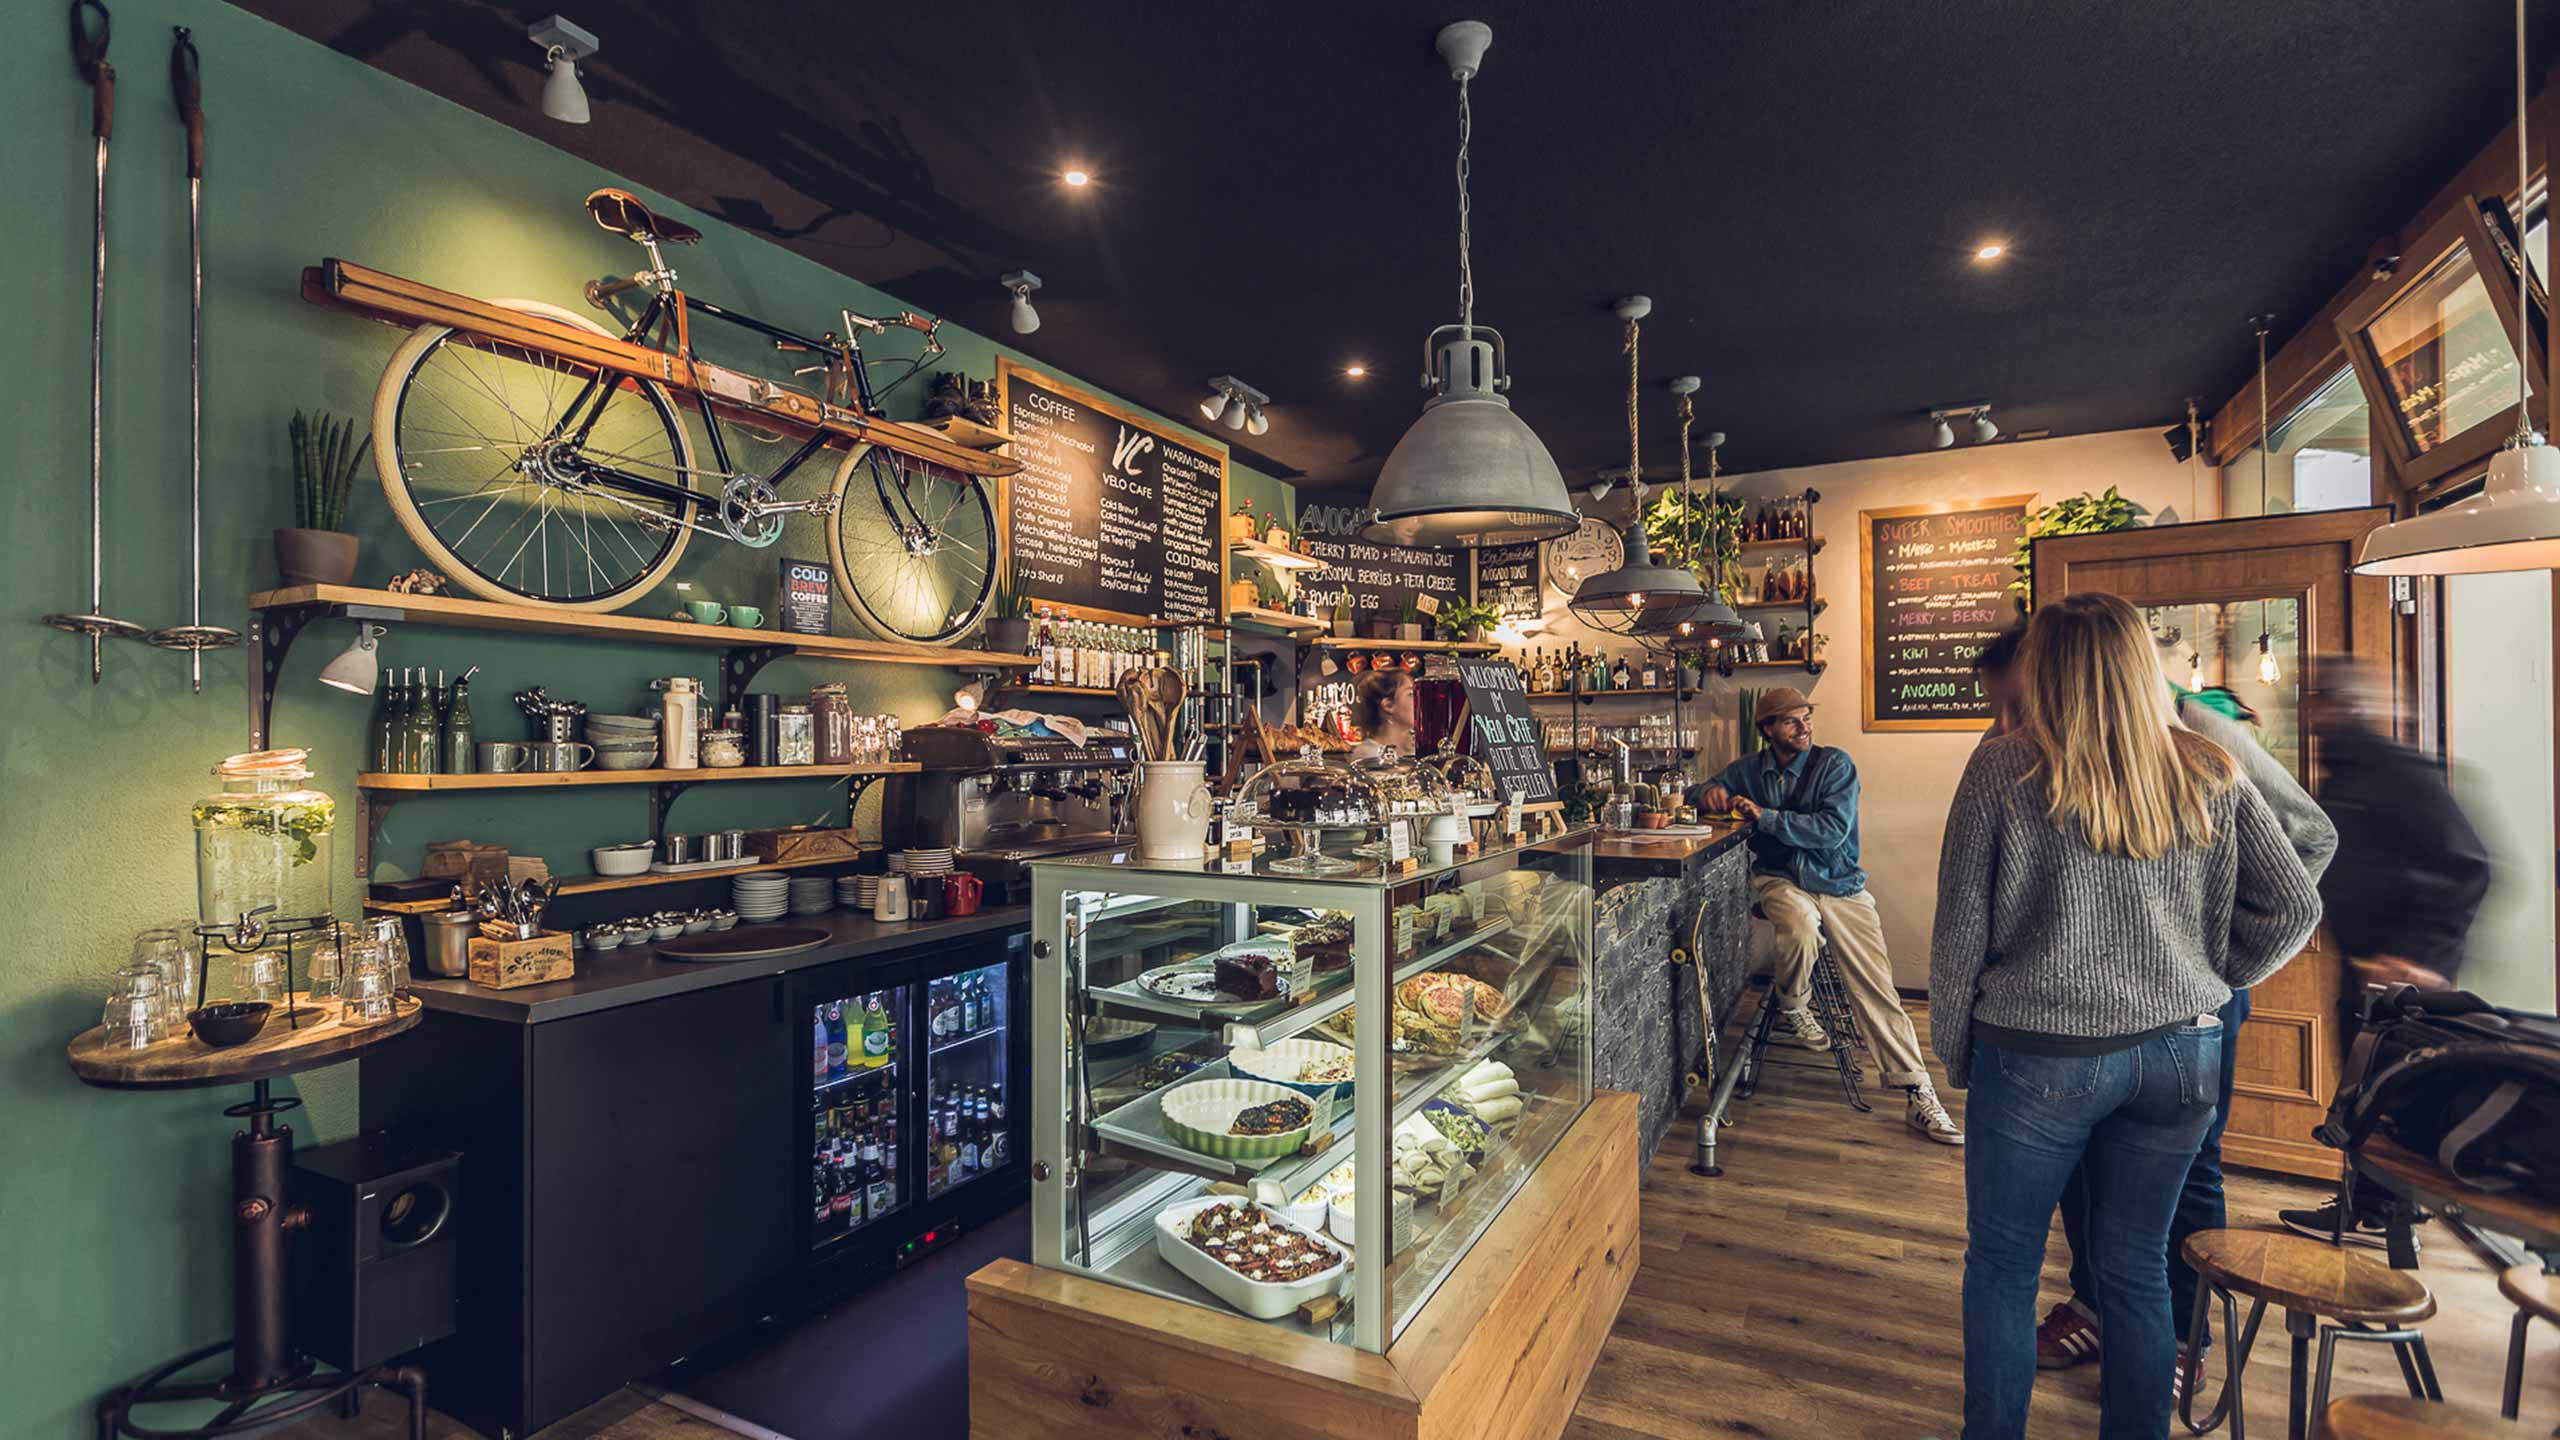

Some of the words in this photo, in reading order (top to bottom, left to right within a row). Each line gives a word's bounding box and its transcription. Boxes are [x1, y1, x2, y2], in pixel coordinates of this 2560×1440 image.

[1013, 403, 1049, 425] Espresso
[1029, 393, 1076, 422] COFFEE
[1112, 425, 1154, 476] VC
[1162, 444, 1193, 468] WARM
[1193, 457, 1221, 479] DRINKS
[1102, 472, 1127, 490] VELO
[1129, 482, 1153, 499] CAFE
[1100, 497, 1117, 510] Cold
[1100, 509, 1117, 522] Cold
[1881, 519, 1931, 541] SUPER
[1946, 513, 2020, 537] SMOOTHIES
[1557, 541, 1568, 552] 10
[1604, 536, 1614, 549] 2
[1898, 543, 1934, 558] MANGO
[1949, 538, 1998, 554] MADNESS
[1166, 551, 1190, 566] COLD
[1191, 556, 1220, 574] DRINKS
[1309, 541, 1345, 562] CHERRY
[1348, 543, 1380, 561] TOMATO
[1390, 547, 1434, 566] HIMALAYAN
[1434, 552, 1455, 568] SALT
[1608, 549, 1617, 563] 3
[791, 567, 828, 582] COLD
[1357, 568, 1392, 587] BERRIES
[1426, 575, 1457, 592] CHEESE
[1899, 577, 1933, 592] BEET
[1951, 572, 2001, 590] TREAT
[791, 579, 828, 593] BREW
[791, 591, 829, 604] COFFEE
[1360, 594, 1380, 610] EGG
[1899, 612, 1936, 626] MERRY
[1952, 609, 1996, 624] BERRY
[1902, 647, 1928, 660] KIWI
[1953, 645, 1985, 660] POW
[1460, 664, 1520, 691] WILLKOMMEN
[1901, 683, 1956, 699] AVOCADO
[1974, 680, 1985, 698] L
[1490, 691, 1507, 714] IM
[1489, 746, 1520, 771] BITTE
[1518, 745, 1543, 770] HIER
[1502, 772, 1552, 801] BESTELLEN
